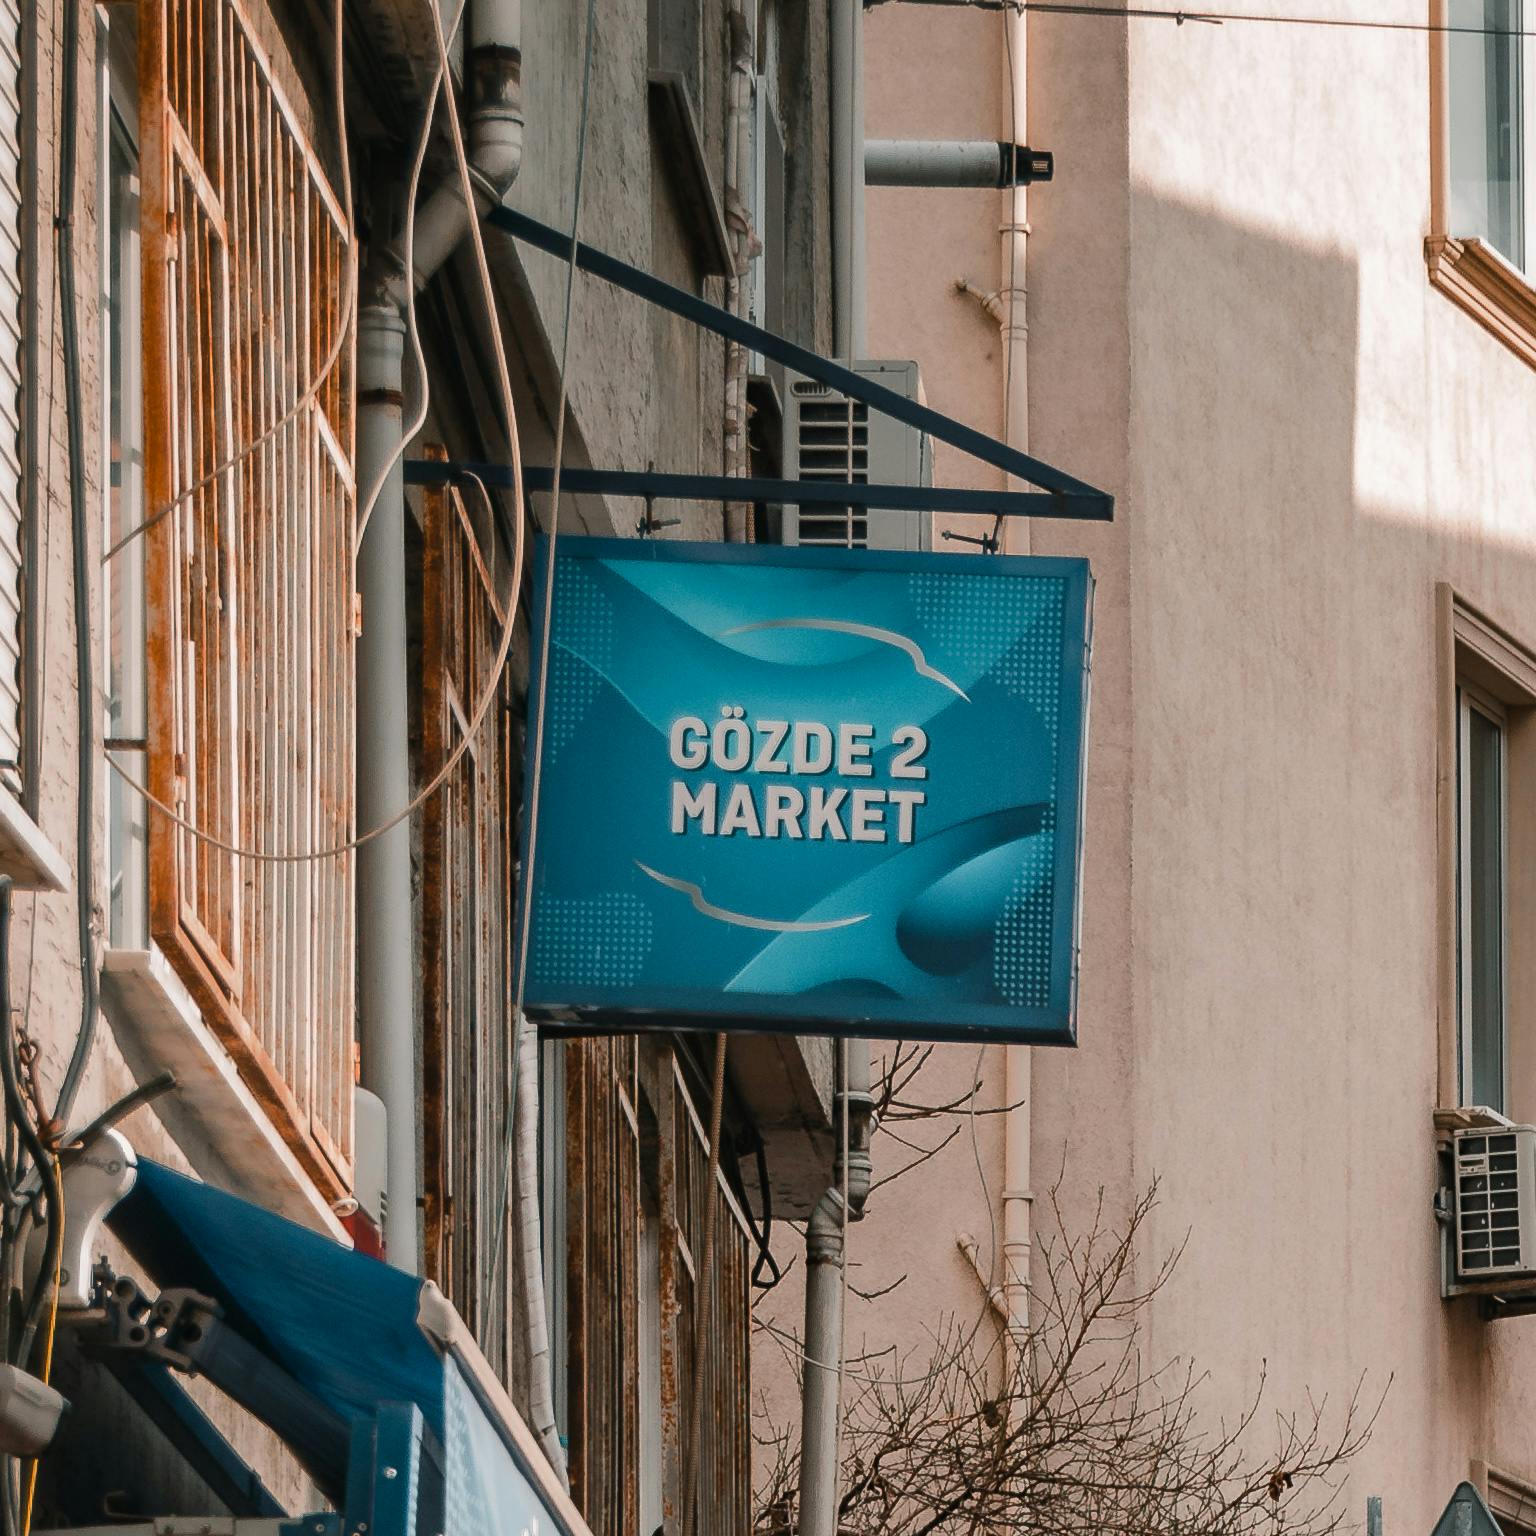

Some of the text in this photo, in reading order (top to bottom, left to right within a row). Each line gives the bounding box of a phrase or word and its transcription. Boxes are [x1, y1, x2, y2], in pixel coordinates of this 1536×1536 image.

[669, 706, 928, 778] GÖZDE 2
[670, 782, 925, 842] MARKET
